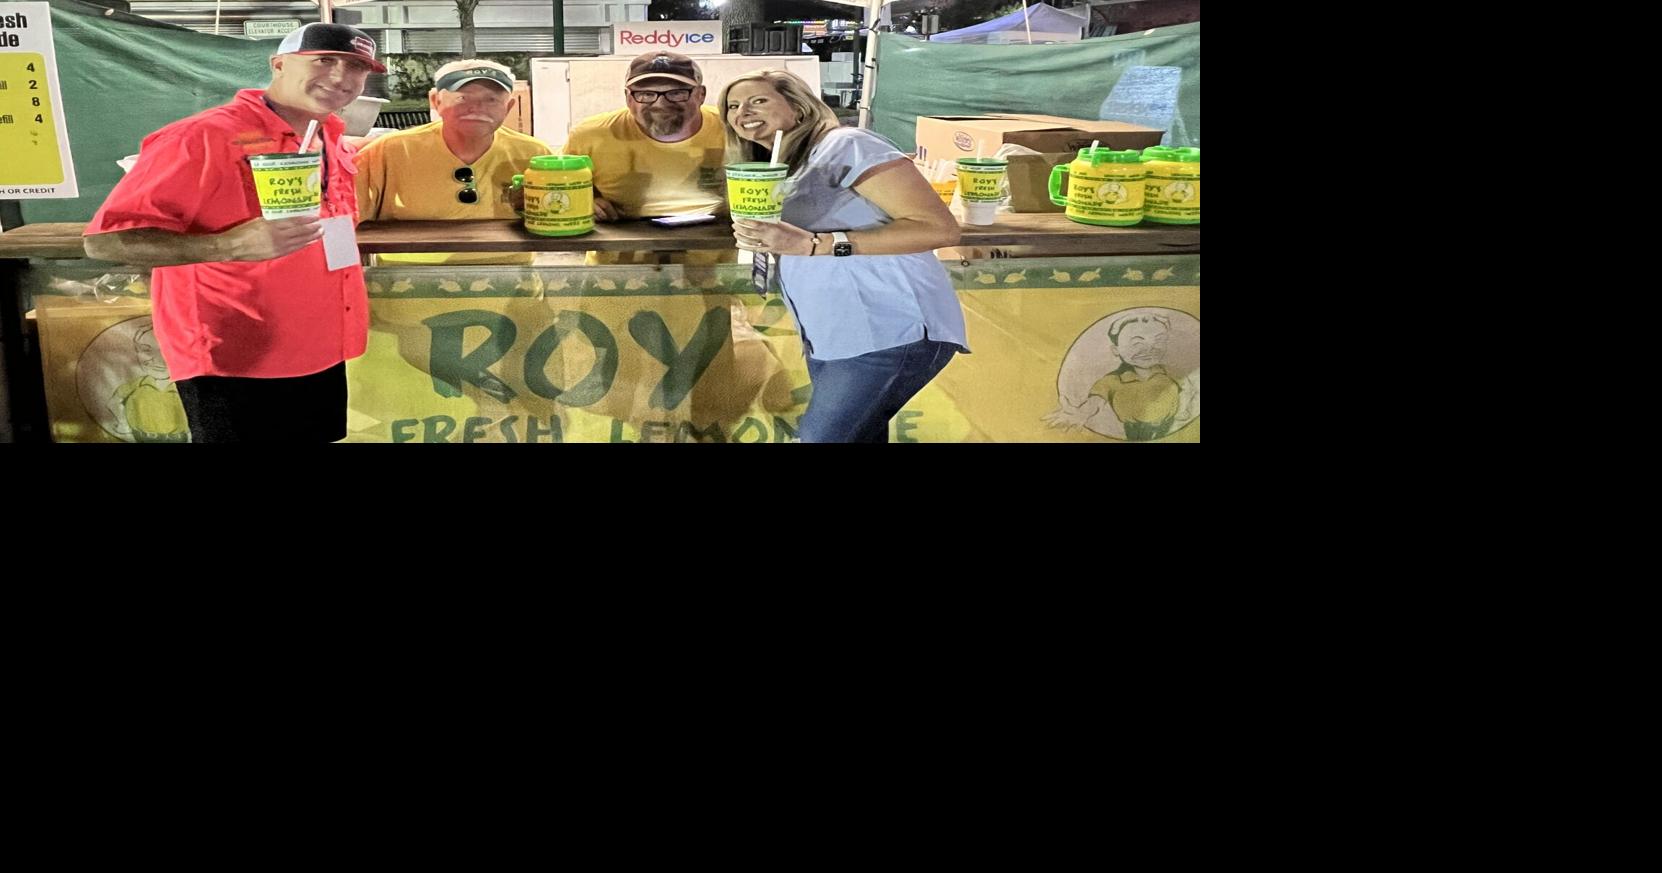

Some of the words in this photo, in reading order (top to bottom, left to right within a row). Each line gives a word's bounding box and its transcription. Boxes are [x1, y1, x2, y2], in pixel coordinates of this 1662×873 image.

[27, 63, 36, 72] 4
[29, 80, 38, 90] 2
[32, 97, 41, 107] 8
[35, 114, 44, 123] 4
[269, 176, 303, 187] ROY'S
[740, 187, 769, 196] ROY'S
[390, 414, 563, 443] FRESH
[610, 410, 922, 443] LEMONE
